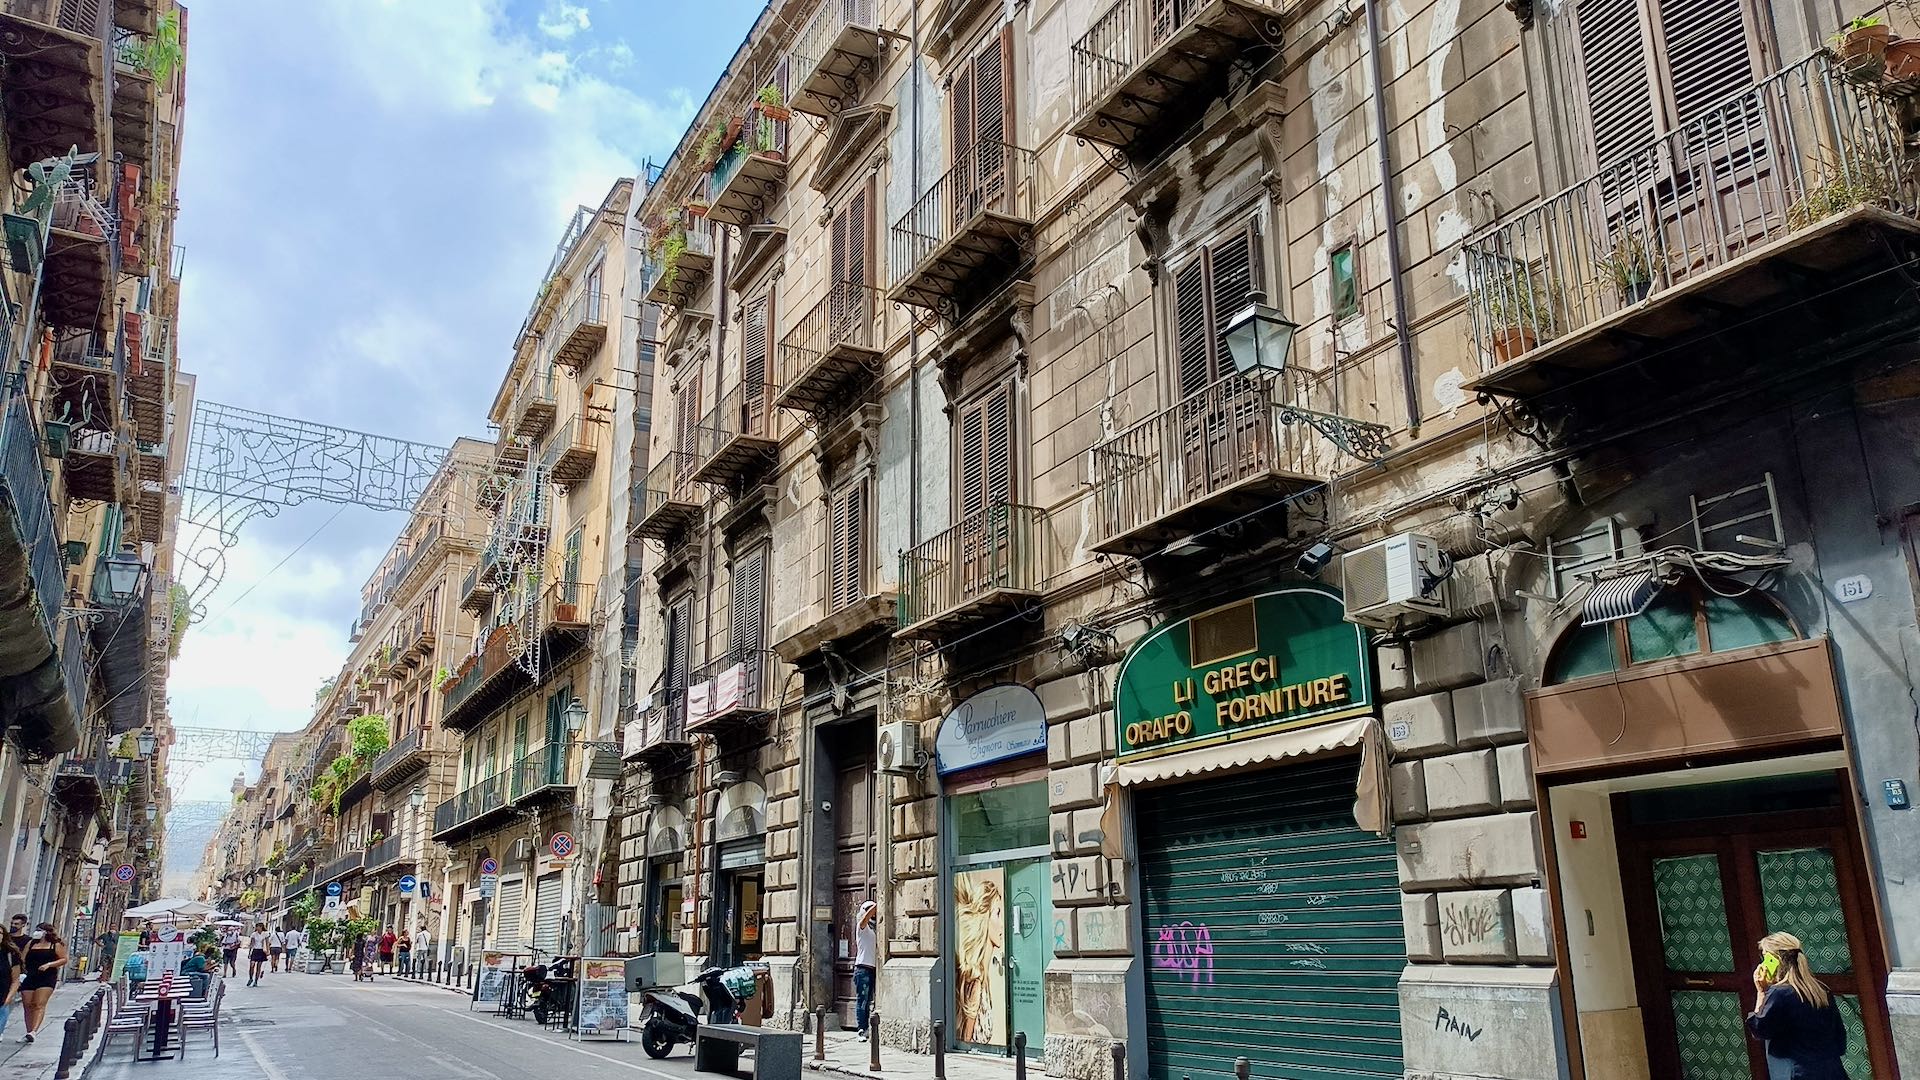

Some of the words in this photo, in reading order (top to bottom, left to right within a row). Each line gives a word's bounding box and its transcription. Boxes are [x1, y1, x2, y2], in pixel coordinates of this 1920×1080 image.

[1841, 581, 1863, 597] 151
[1174, 677, 1195, 704] LI
[1203, 655, 1279, 696] GRECI
[1125, 711, 1194, 746] ORAFO
[1216, 673, 1349, 727] FORNITURE
